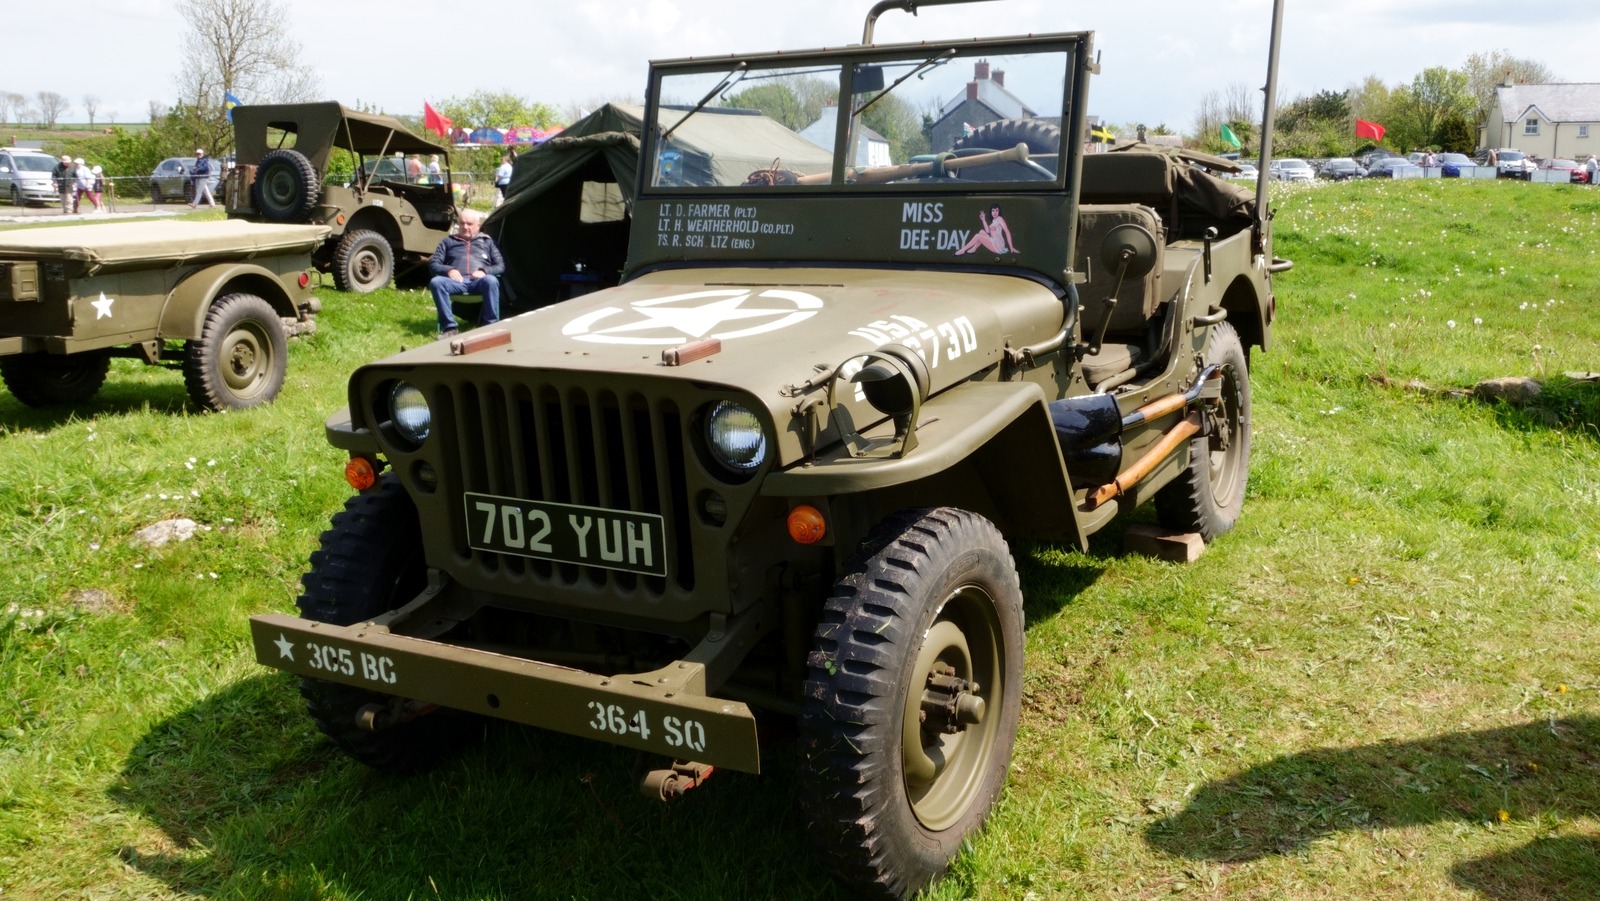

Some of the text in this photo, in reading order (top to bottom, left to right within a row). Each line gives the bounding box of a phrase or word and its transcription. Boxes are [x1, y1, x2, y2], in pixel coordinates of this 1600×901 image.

[659, 203, 672, 217] LT.
[676, 203, 686, 217] D.
[688, 203, 731, 218] FARMER
[902, 202, 944, 223] MISS
[658, 219, 671, 232] LT.
[674, 219, 684, 232] H.
[687, 219, 759, 234] WEATHERHOLD
[672, 234, 682, 247] R.
[685, 234, 729, 249] SCHLTZ
[475, 501, 653, 566] 702 YUH
[306, 642, 397, 684] 305 BG
[588, 701, 706, 752] 364 SQ
